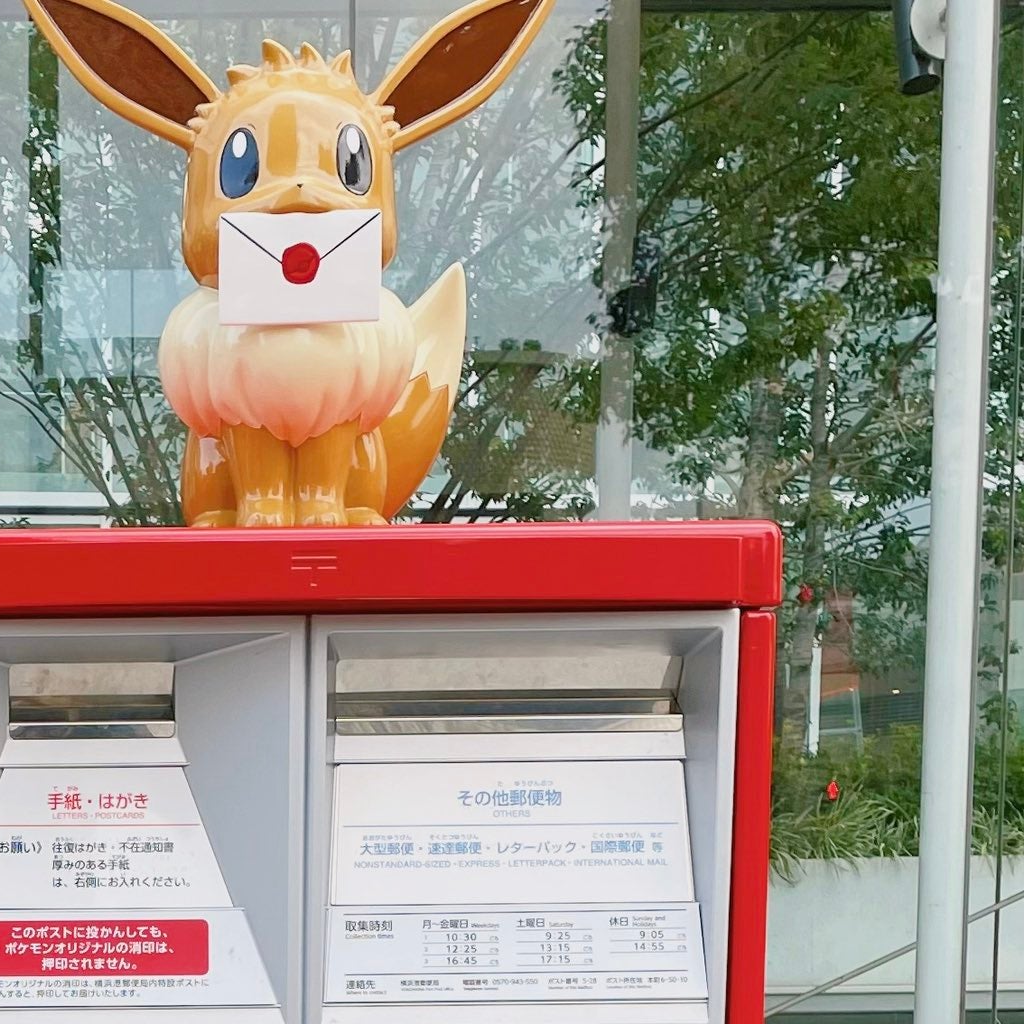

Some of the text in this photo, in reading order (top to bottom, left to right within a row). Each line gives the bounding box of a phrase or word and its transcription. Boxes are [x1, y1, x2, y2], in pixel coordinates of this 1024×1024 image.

[47, 793, 149, 811] 手紙・はがき
[457, 789, 562, 807] その他郵便物
[52, 812, 145, 820] LETTERS POSTCARDS
[493, 809, 531, 818] OTHERS
[458, 859, 501, 868] EXPRESS
[508, 859, 567, 868] LETTERPACK
[574, 858, 644, 868] INTERNATIONAL
[647, 858, 668, 866] MAIL
[345, 920, 393, 932] 取集時刻
[516, 918, 545, 928] 土曜日
[609, 916, 629, 927] 休日
[11, 926, 168, 939] このポストに投かんしても、
[5, 942, 175, 954] ポケモンオリジナルの消印は、
[41, 958, 138, 971] 押印されません。
